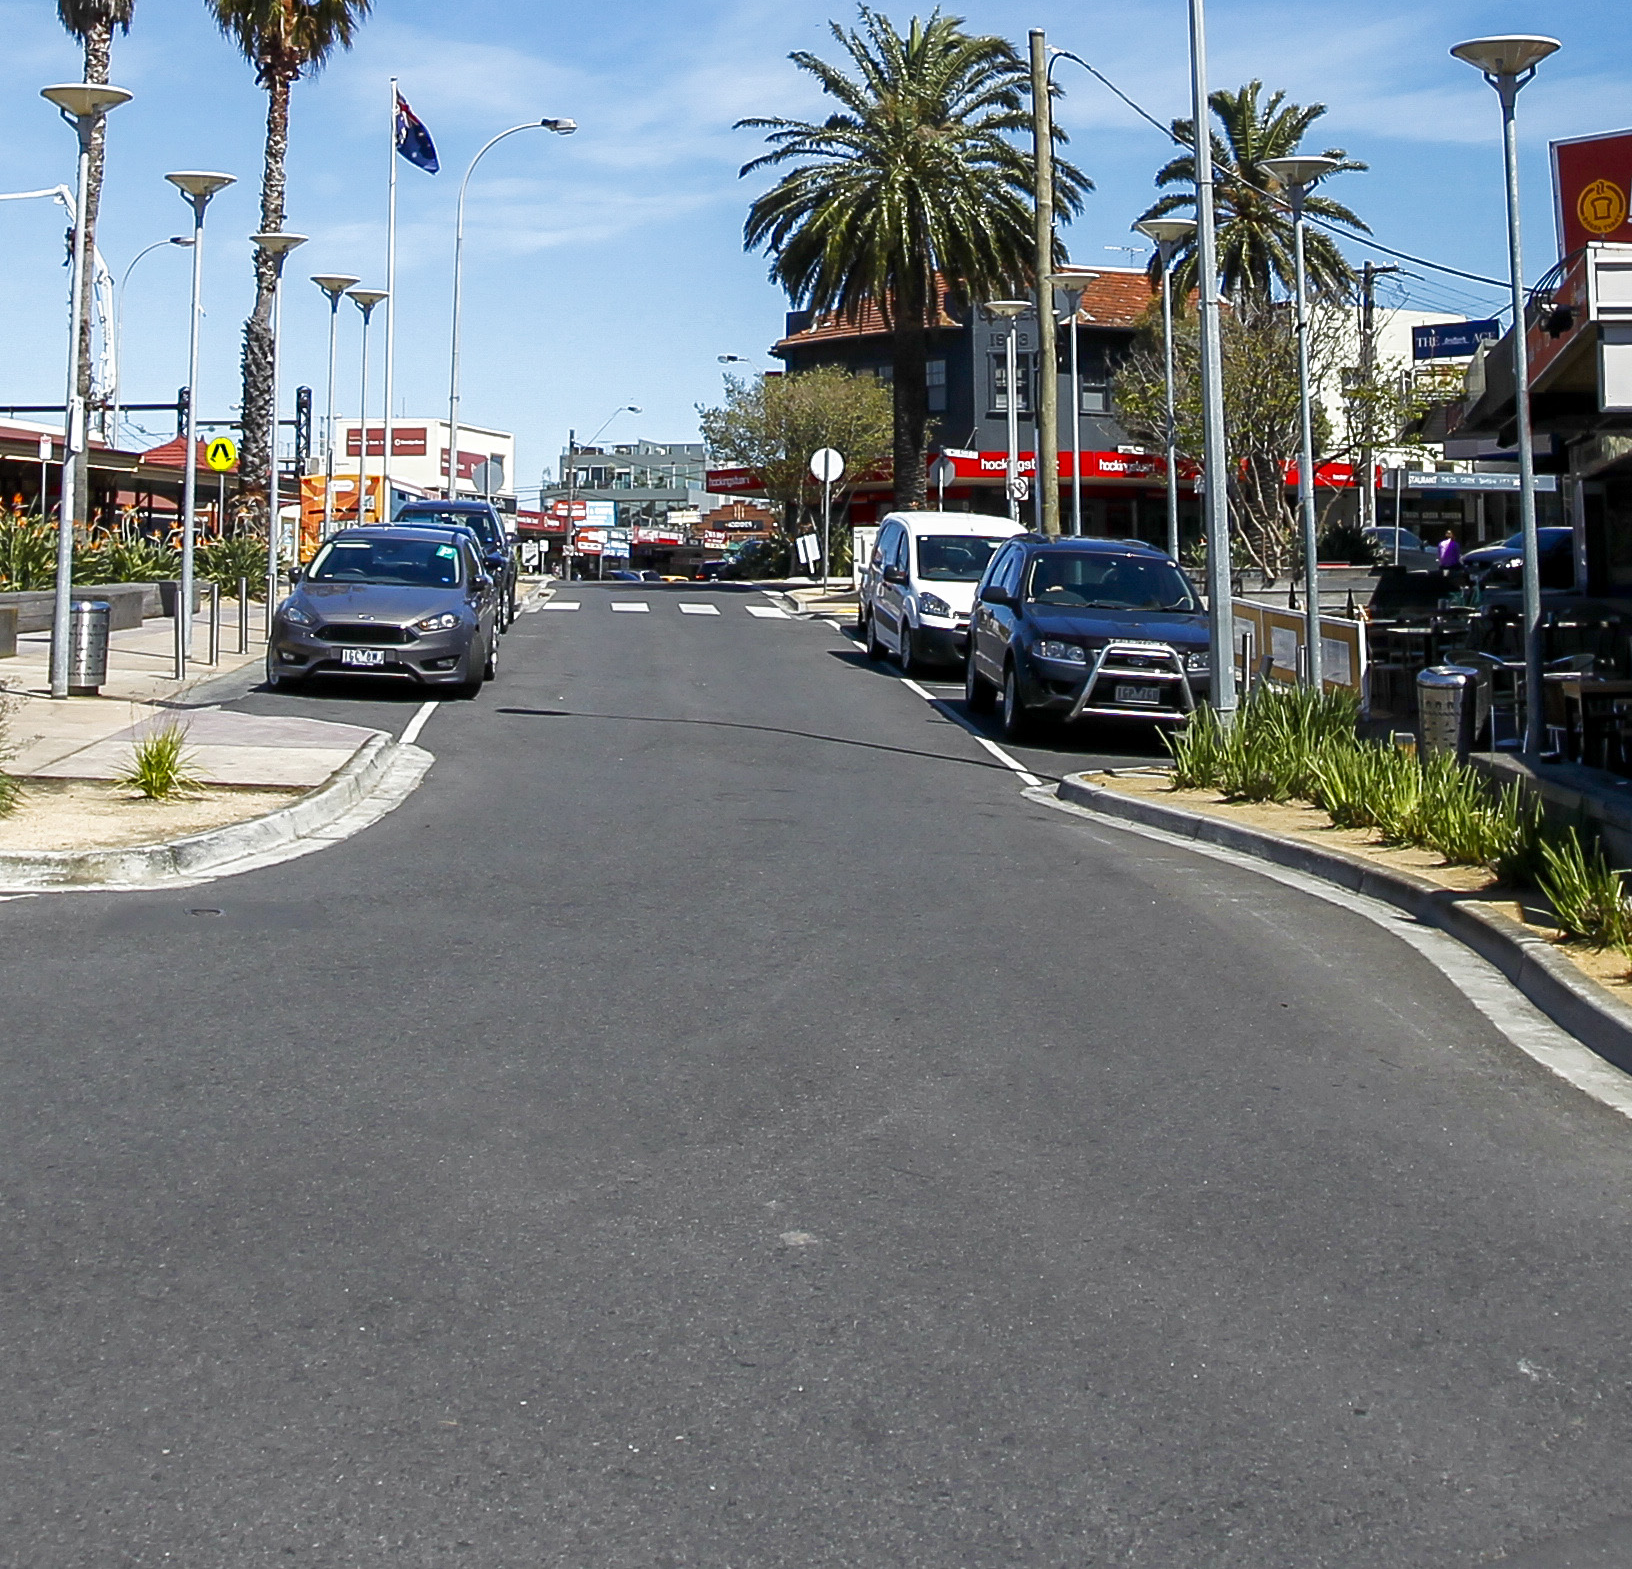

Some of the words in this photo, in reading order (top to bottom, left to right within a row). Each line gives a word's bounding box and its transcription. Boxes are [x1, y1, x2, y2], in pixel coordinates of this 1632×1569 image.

[990, 333, 1029, 346] 193
[1416, 335, 1440, 348] THE
[439, 546, 453, 556] P
